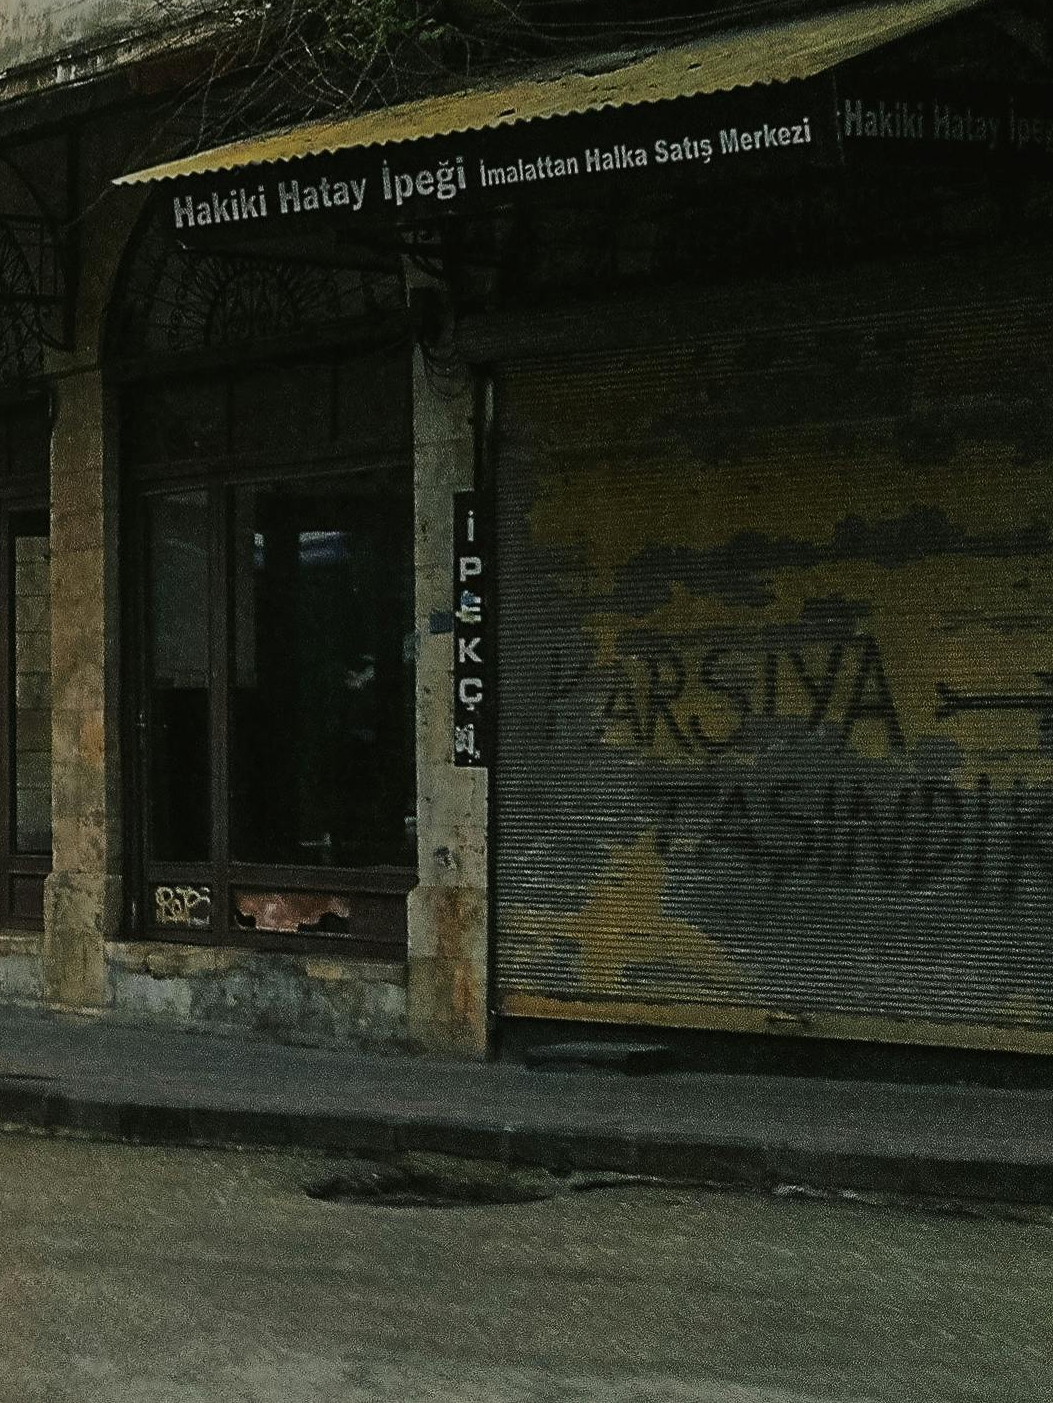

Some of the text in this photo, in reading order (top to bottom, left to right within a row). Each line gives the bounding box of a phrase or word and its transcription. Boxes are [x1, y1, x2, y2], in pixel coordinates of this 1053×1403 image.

[844, 98, 924, 140] Hakiki
[932, 100, 999, 152] Hatay
[172, 184, 268, 229] Hakiki
[277, 176, 367, 214] Hatay
[380, 155, 467, 206] İpeği
[584, 144, 648, 174] Halka
[654, 134, 714, 165] Satış
[719, 116, 813, 156] Merkezi
